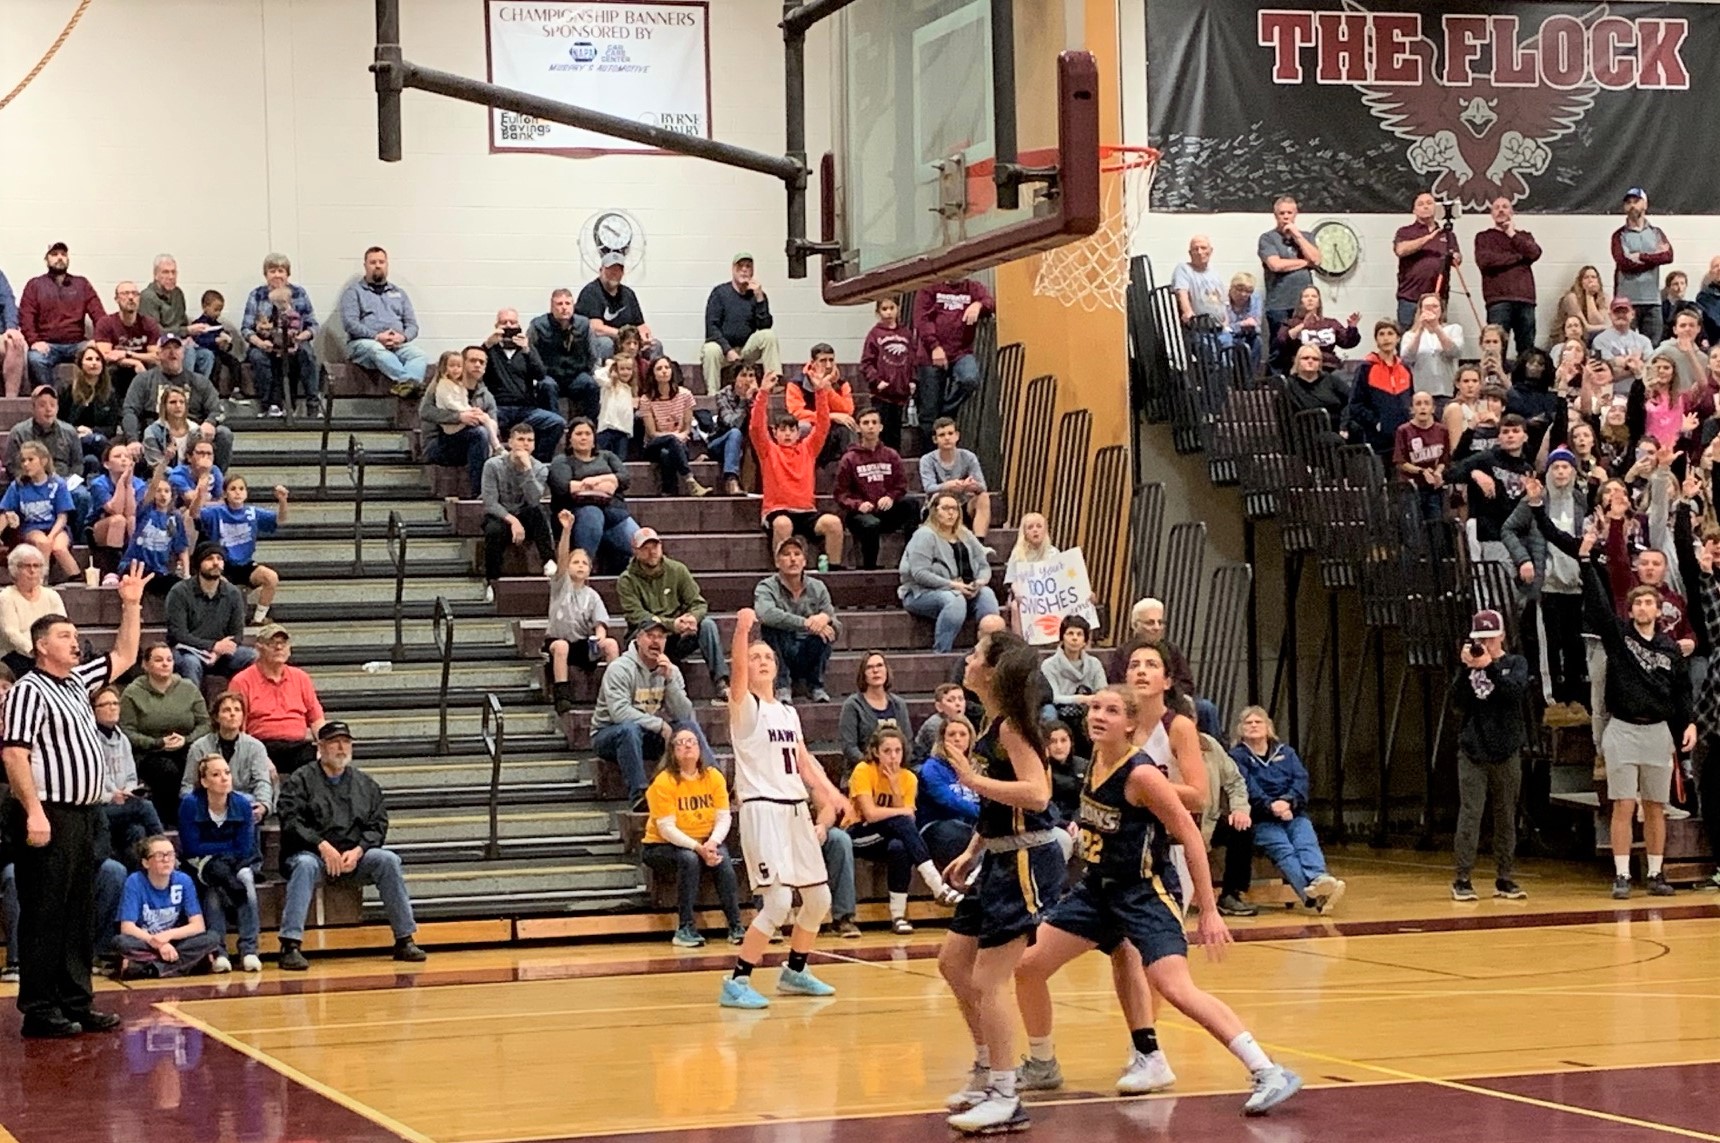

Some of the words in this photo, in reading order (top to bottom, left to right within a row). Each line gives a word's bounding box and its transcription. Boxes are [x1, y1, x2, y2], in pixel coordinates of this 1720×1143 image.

[499, 6, 619, 23] CHAMPIONSHIP
[625, 10, 696, 26] BANNERS
[542, 25, 630, 39] SPONSORED
[635, 27, 653, 39] BY
[1258, 10, 1422, 85] THE
[1442, 15, 1690, 90] FLOCK
[500, 121, 551, 136] Savings
[502, 130, 533, 140] Bank
[767, 729, 799, 743] HAW
[678, 794, 714, 811] LIONS
